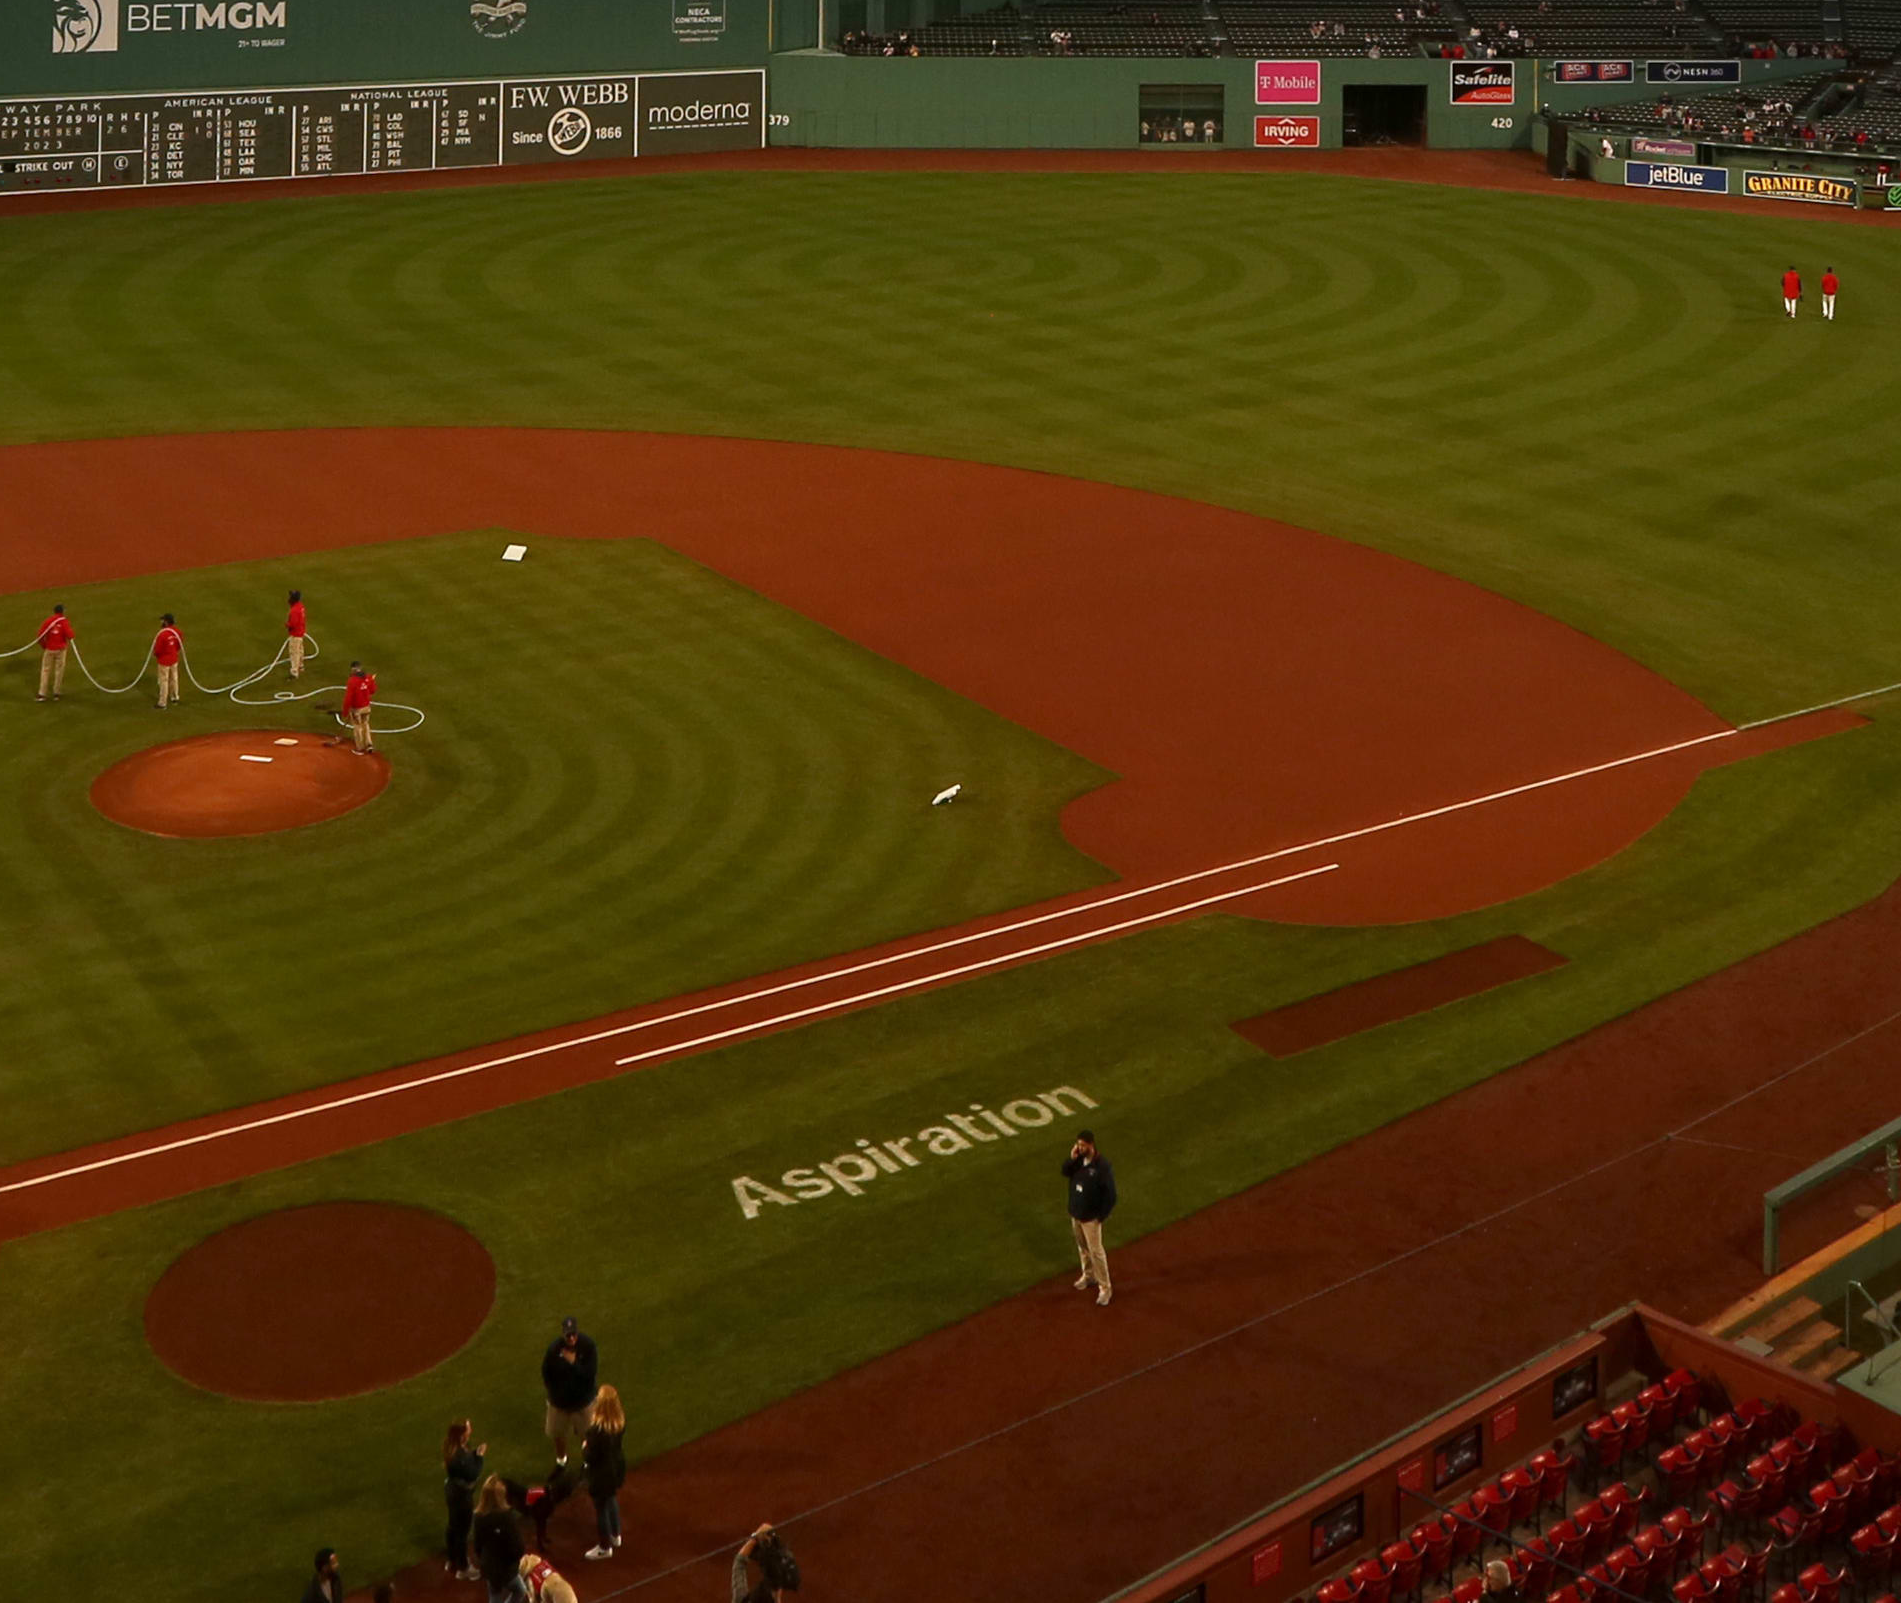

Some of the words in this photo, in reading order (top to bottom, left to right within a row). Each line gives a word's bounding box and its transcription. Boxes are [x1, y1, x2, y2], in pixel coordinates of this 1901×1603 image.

[127, 0, 287, 32] BETMGM
[1683, 68, 1708, 77] NESN
[1274, 76, 1316, 90] Mobile
[1454, 72, 1512, 87] Safelite
[350, 91, 403, 100] NATIONAL
[407, 88, 448, 98] LEAGUE
[557, 83, 630, 106] WEBB
[55, 102, 101, 113] PARK
[164, 98, 224, 108] AMERICAN
[229, 96, 273, 106] LEAGUE
[386, 113, 403, 122] LAD
[649, 100, 751, 123] moderna
[238, 119, 257, 129] HOU
[769, 114, 791, 127] 379
[1491, 117, 1513, 129] 420
[167, 132, 185, 141] CLE
[239, 129, 256, 138] SEA
[512, 131, 543, 145] Since
[595, 126, 623, 141] 1866
[1263, 125, 1309, 138] IRVING
[239, 138, 256, 147] TEX
[316, 135, 332, 143] STL
[166, 151, 184, 160] DET
[238, 148, 255, 157] LAA
[14, 162, 49, 173] STRIKE
[52, 160, 74, 171] OUT
[166, 161, 183, 170] NYY
[316, 162, 332, 171] ATL
[166, 170, 184, 179] TOR
[1647, 165, 1704, 186] jetBlue
[1747, 175, 1815, 193] GRANITE
[1817, 180, 1854, 200] CITY
[731, 1085, 1100, 1220] Aspiration
